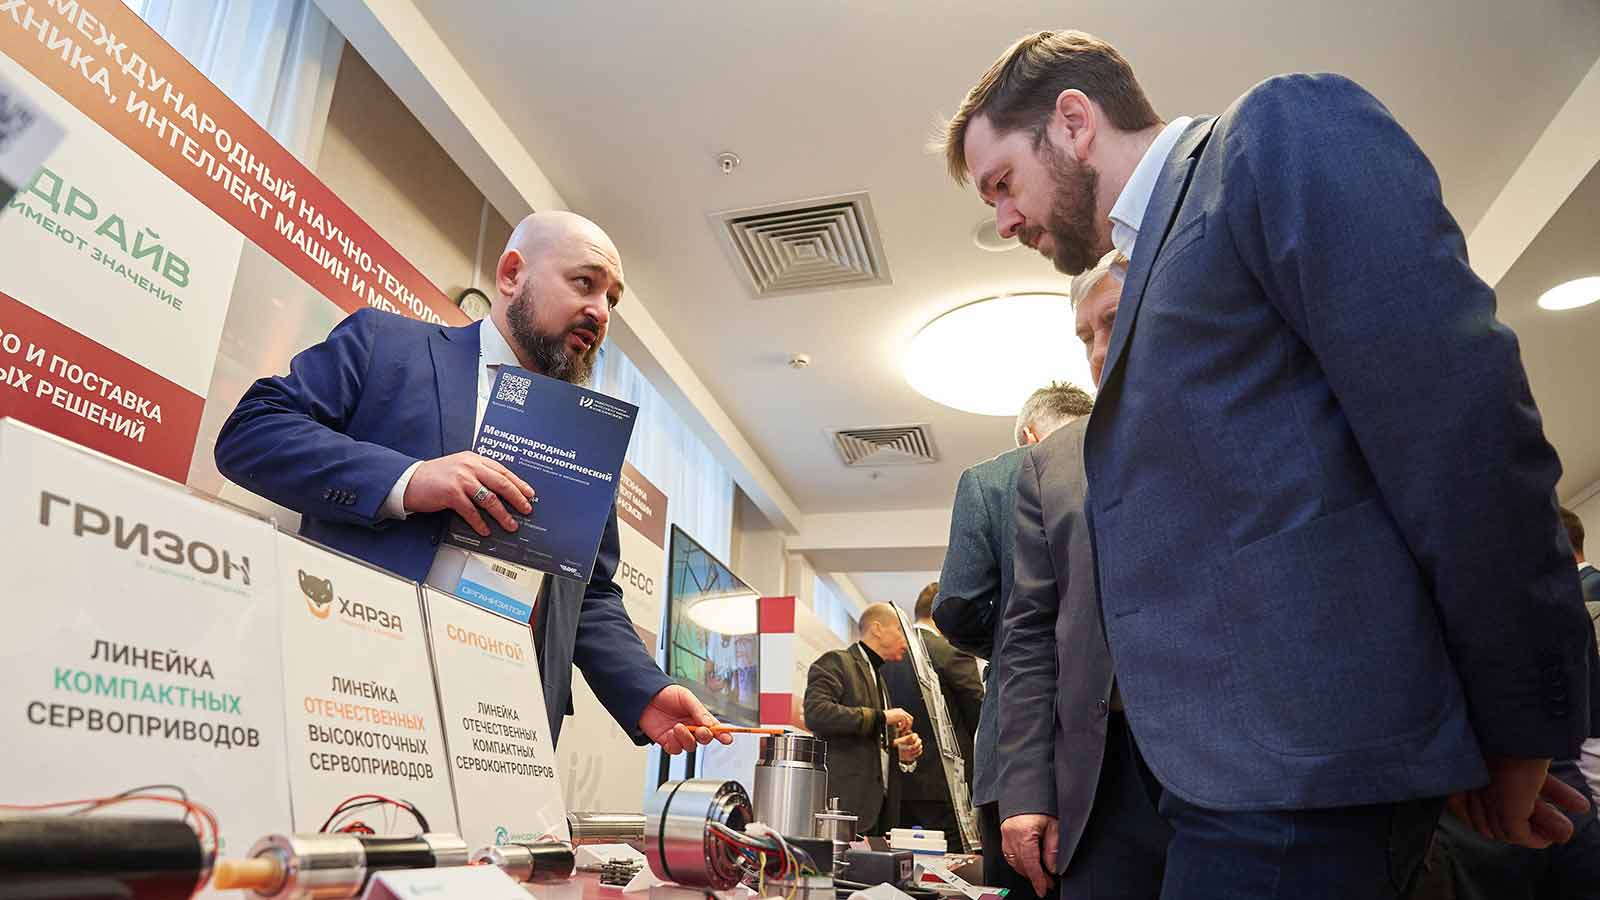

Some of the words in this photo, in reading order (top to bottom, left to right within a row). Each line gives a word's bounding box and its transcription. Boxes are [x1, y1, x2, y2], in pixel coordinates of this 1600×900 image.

[48, 0, 296, 208] МЕЖДУНАРОДНЫЙ
[126, 90, 273, 220] ИНТЕЛЛЕКТ
[274, 211, 350, 286] МАШИН
[351, 274, 366, 298] И
[90, 247, 183, 311] ЗНАЧЕНИЕ
[26, 343, 46, 367] И
[49, 354, 162, 425] ПОСТАВКА
[36, 379, 147, 443] РЕШЕНИЙ
[477, 445, 515, 463] форум
[480, 436, 613, 482] научно-технологический
[483, 424, 577, 460] Международный
[39, 490, 251, 586] ГРИЗОН
[620, 559, 654, 595] РЕСС
[338, 595, 403, 632] ХАРЗА
[91, 639, 215, 679] ЛИНЕЙКА
[54, 666, 241, 714] КОМПАКТНЫХ
[332, 676, 399, 703] ЛИНЕЙКА
[27, 700, 260, 749] СЕРВОПРИВОДОВ
[304, 697, 425, 731] ОТЕЧЕСТВЕННЫХ
[462, 718, 538, 741] ОТЕЧЕСТВЕННЫХ
[478, 702, 520, 721] ЛИНЕЙКА
[308, 724, 428, 754] ВЫСОКОТОЧНЫХ
[472, 738, 536, 758] КОМПАКТНЫХ
[310, 752, 433, 781] СЕРВОПРИВОДОВ
[456, 755, 554, 778] СЕРВОКОНТРОЛЛЕРОВ
